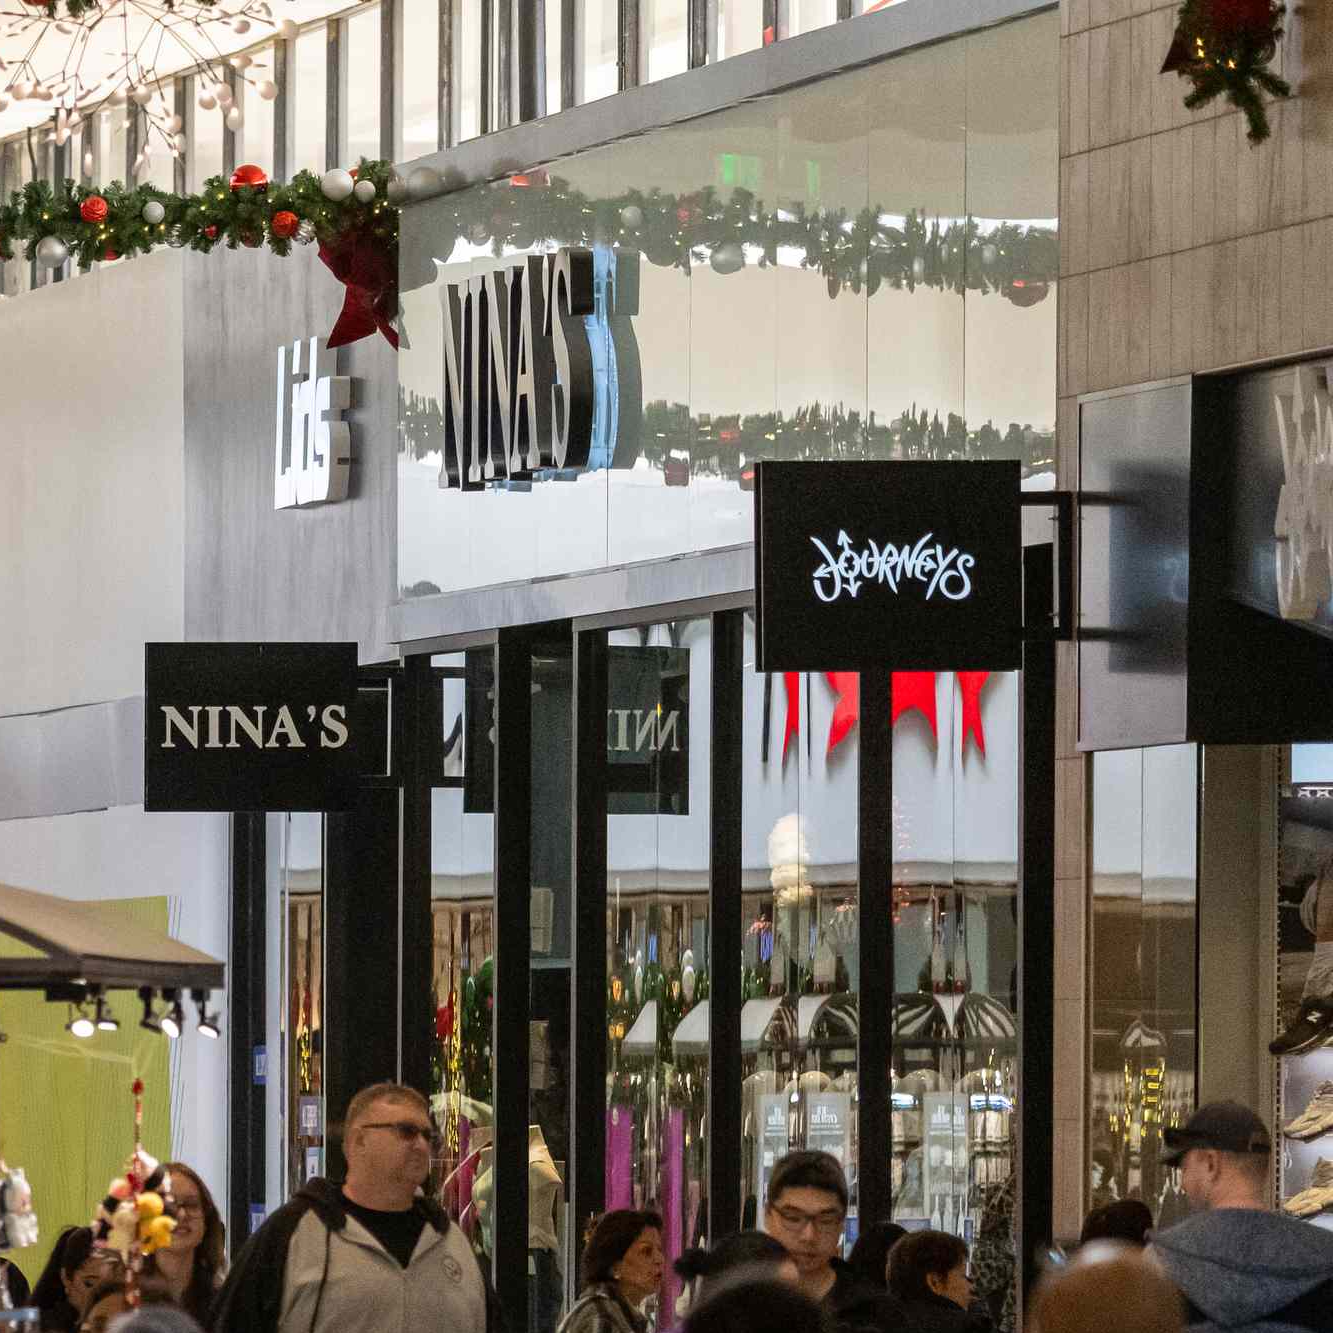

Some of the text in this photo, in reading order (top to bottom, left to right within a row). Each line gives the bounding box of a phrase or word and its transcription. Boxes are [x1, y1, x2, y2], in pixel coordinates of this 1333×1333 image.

[274, 336, 341, 511] Lids
[437, 247, 583, 490] NINA'S
[160, 704, 349, 750] NINA'S
